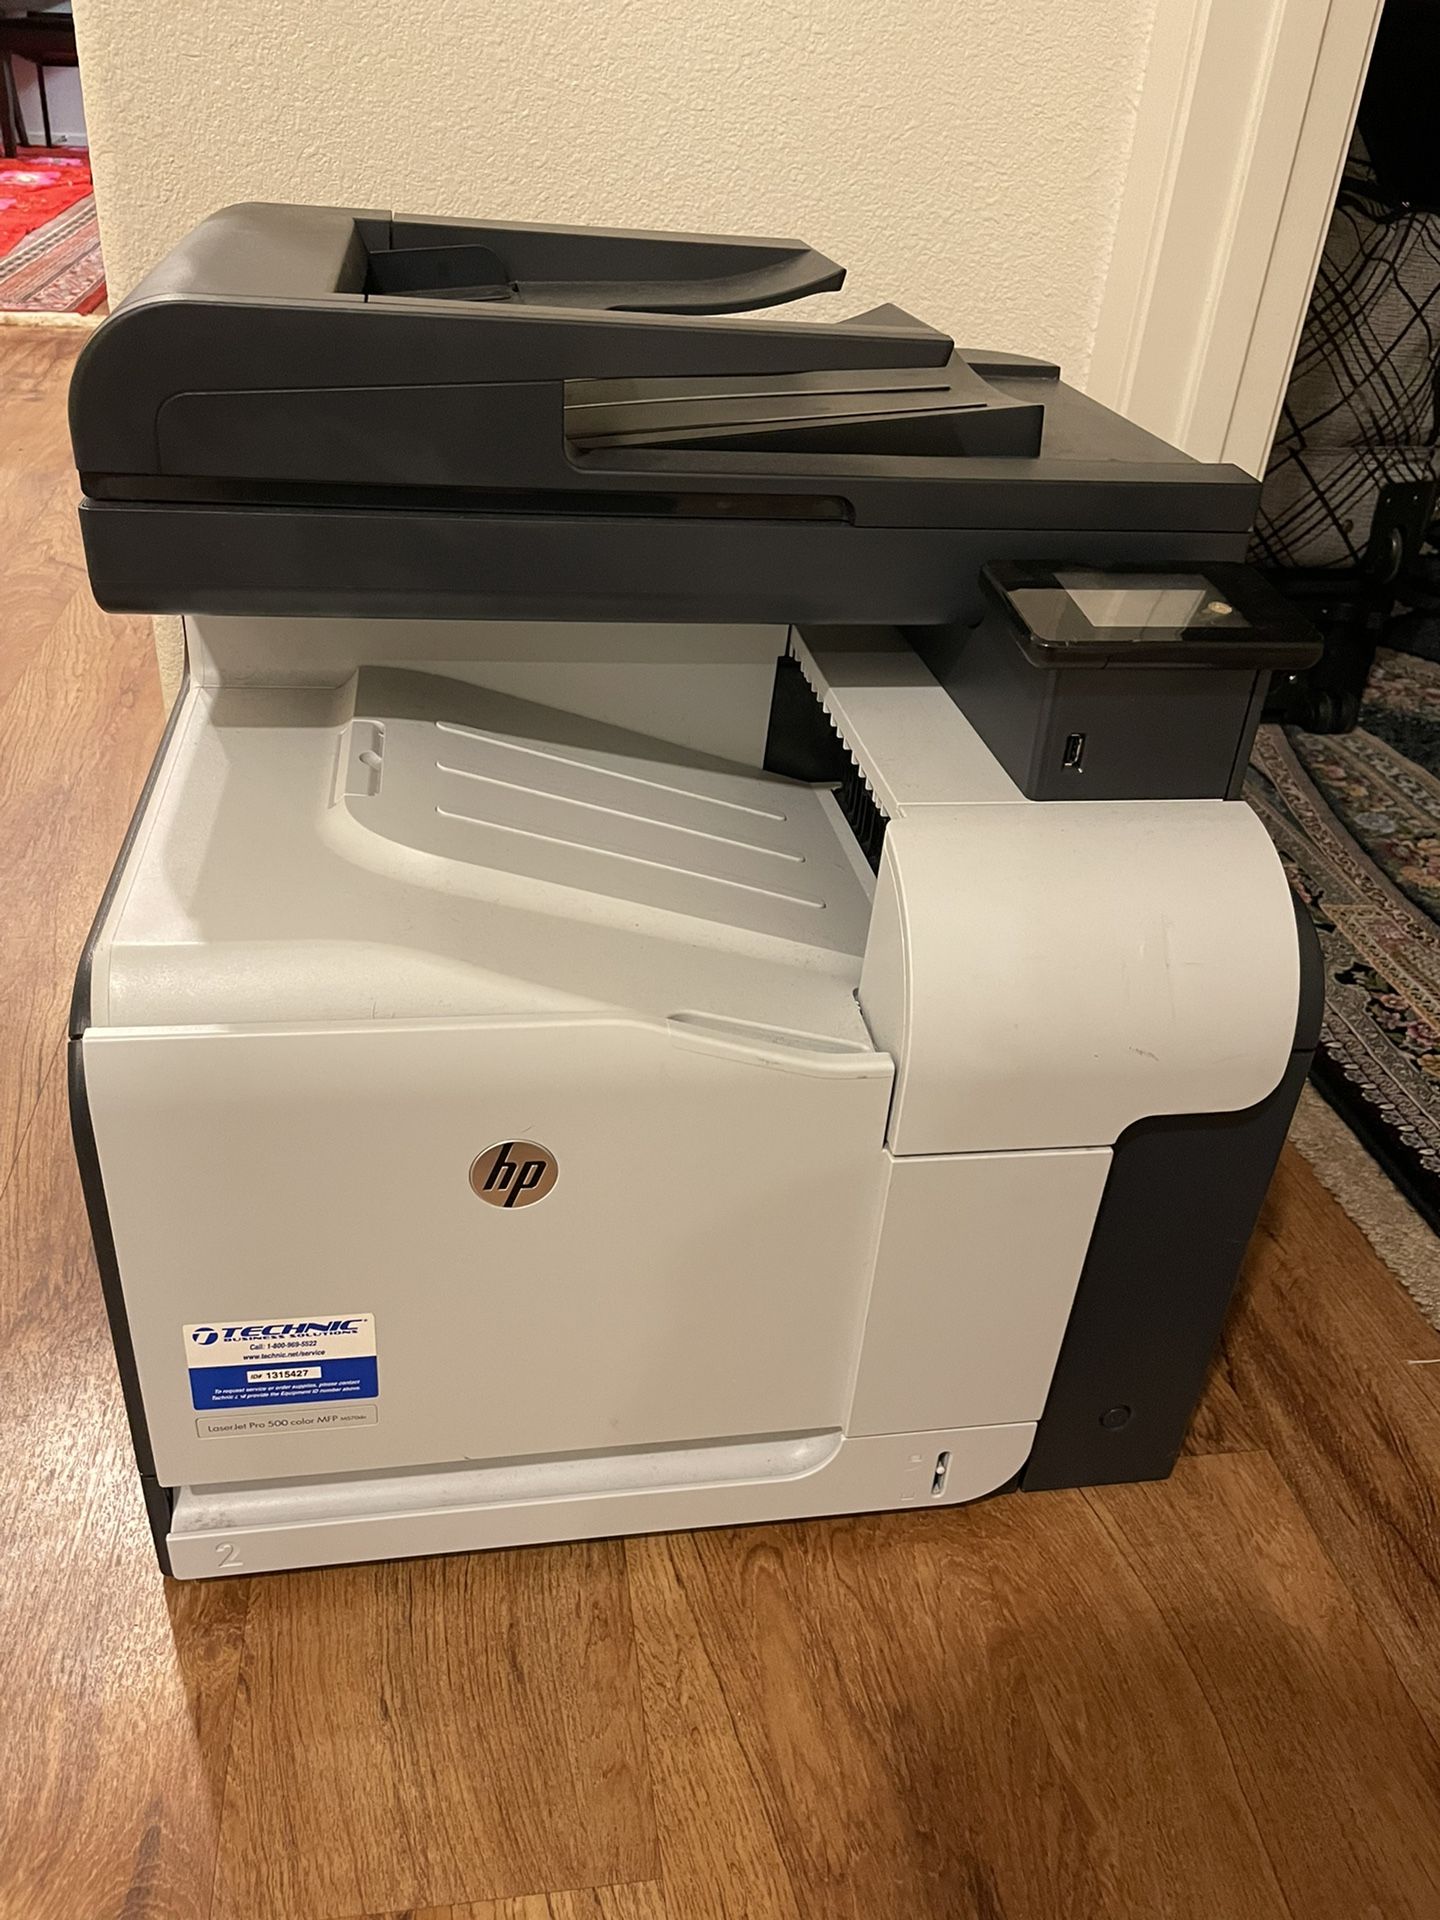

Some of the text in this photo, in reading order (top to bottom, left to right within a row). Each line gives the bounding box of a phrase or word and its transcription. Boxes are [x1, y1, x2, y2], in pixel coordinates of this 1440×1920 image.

[482, 1142, 547, 1207] hp
[222, 1319, 363, 1338] TECHNIC
[289, 1330, 358, 1338] SOLUTIONS
[243, 1350, 326, 1360] www.technic.net/service
[266, 1369, 309, 1379] 1315427
[207, 1422, 247, 1432] LaserJet
[249, 1421, 266, 1429] Pro
[268, 1418, 289, 1428] 500
[290, 1417, 314, 1426] color
[317, 1415, 338, 1423] MFP
[215, 1541, 243, 1568] 2
